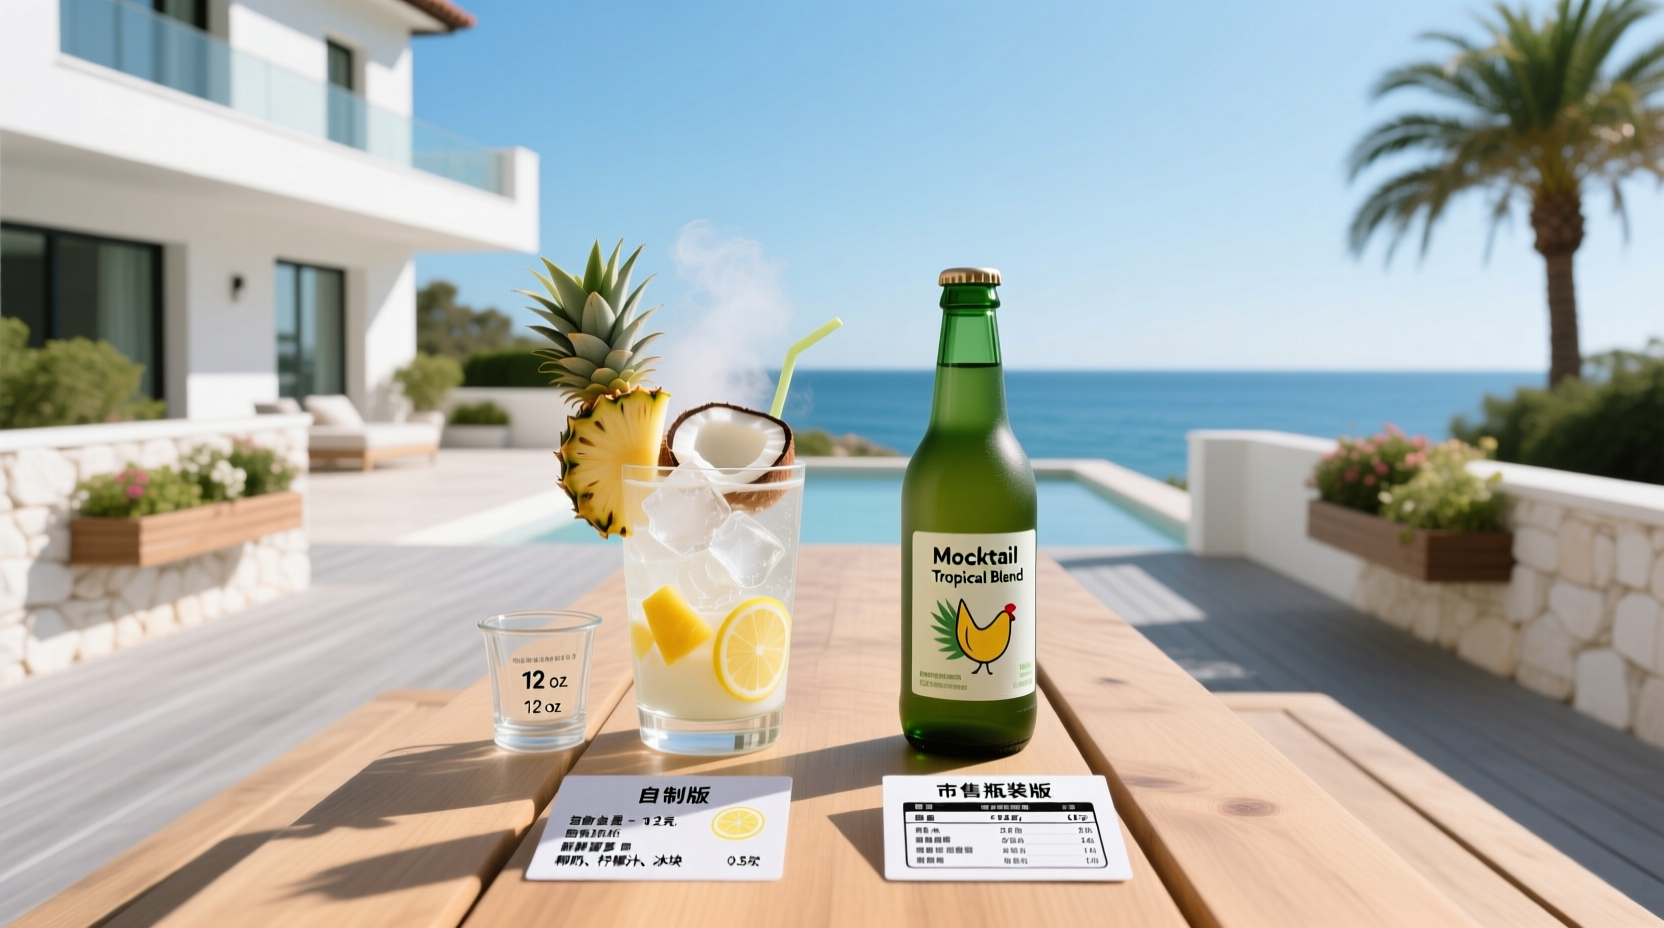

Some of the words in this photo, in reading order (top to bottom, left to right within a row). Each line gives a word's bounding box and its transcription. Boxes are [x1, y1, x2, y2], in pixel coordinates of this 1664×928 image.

[933, 546, 1018, 565] Mocktail
[932, 569, 987, 588] Tropical
[990, 568, 1024, 583] Blend
[522, 670, 545, 690] 12
[549, 676, 568, 689] oz
[524, 700, 542, 714] 12
[545, 702, 562, 713] oz
[638, 786, 711, 805] 自制版
[936, 782, 1052, 799] 市售瓶装版
